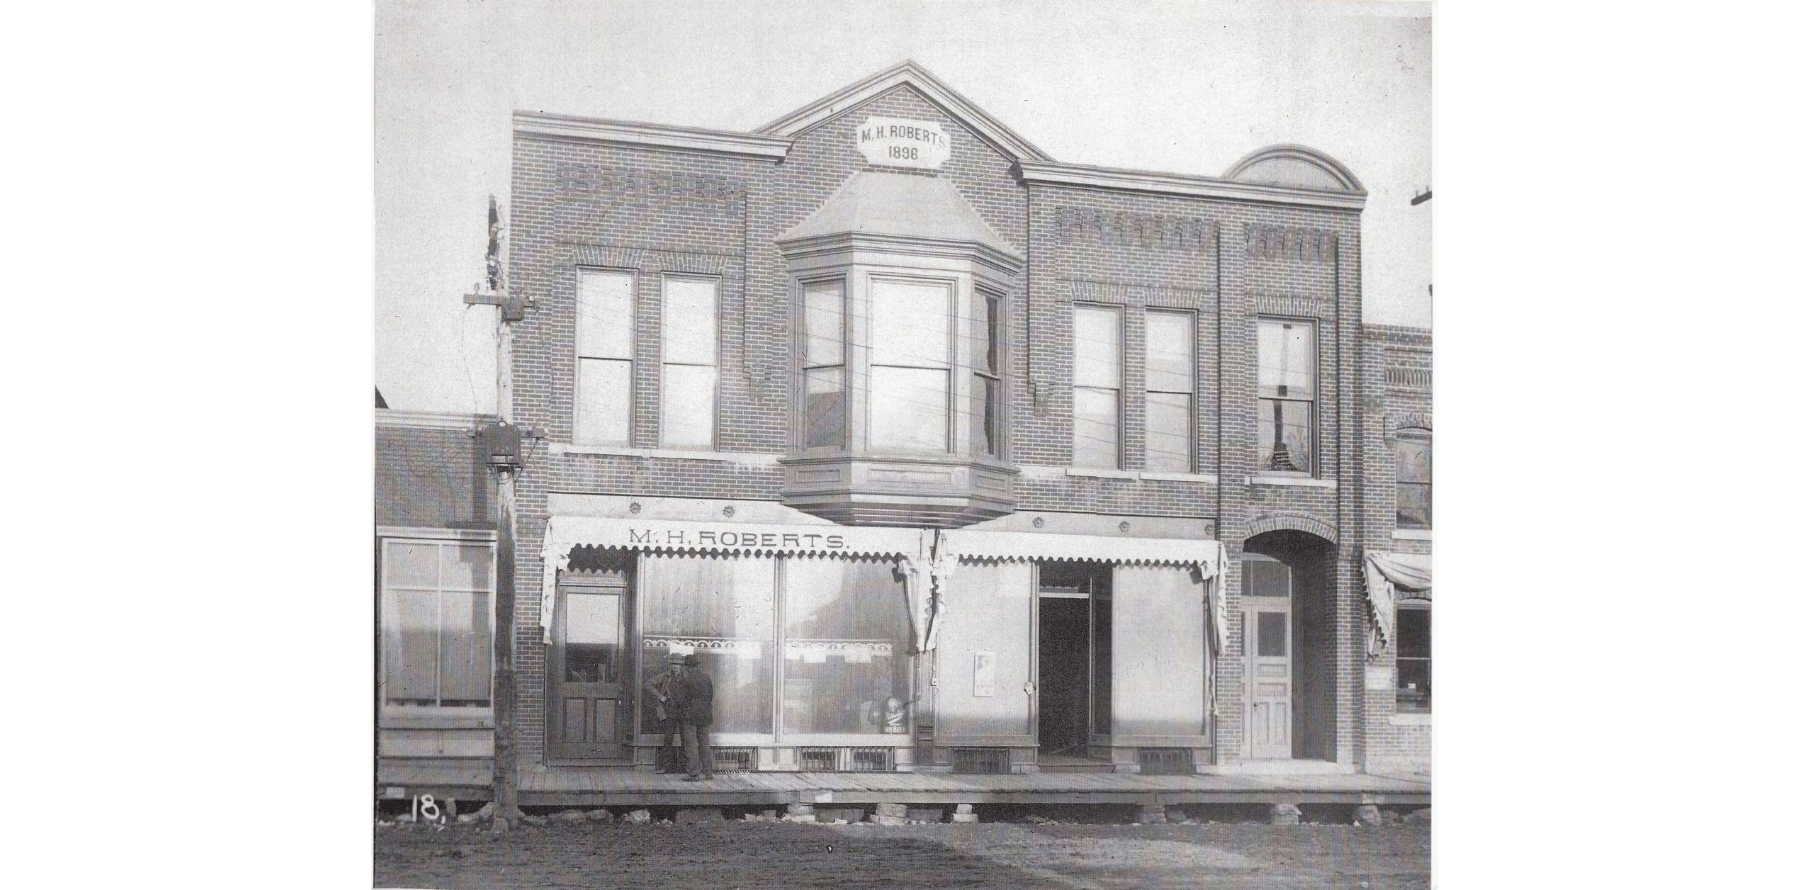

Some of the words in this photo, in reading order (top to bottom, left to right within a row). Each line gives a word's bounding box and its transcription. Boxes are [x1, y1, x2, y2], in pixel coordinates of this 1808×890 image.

[861, 127, 875, 143] M.
[876, 125, 888, 139] H.
[890, 125, 946, 149] ROBERTS
[888, 145, 919, 161] 1896
[629, 528, 659, 544] M.
[698, 531, 850, 549] ROBERTS.
